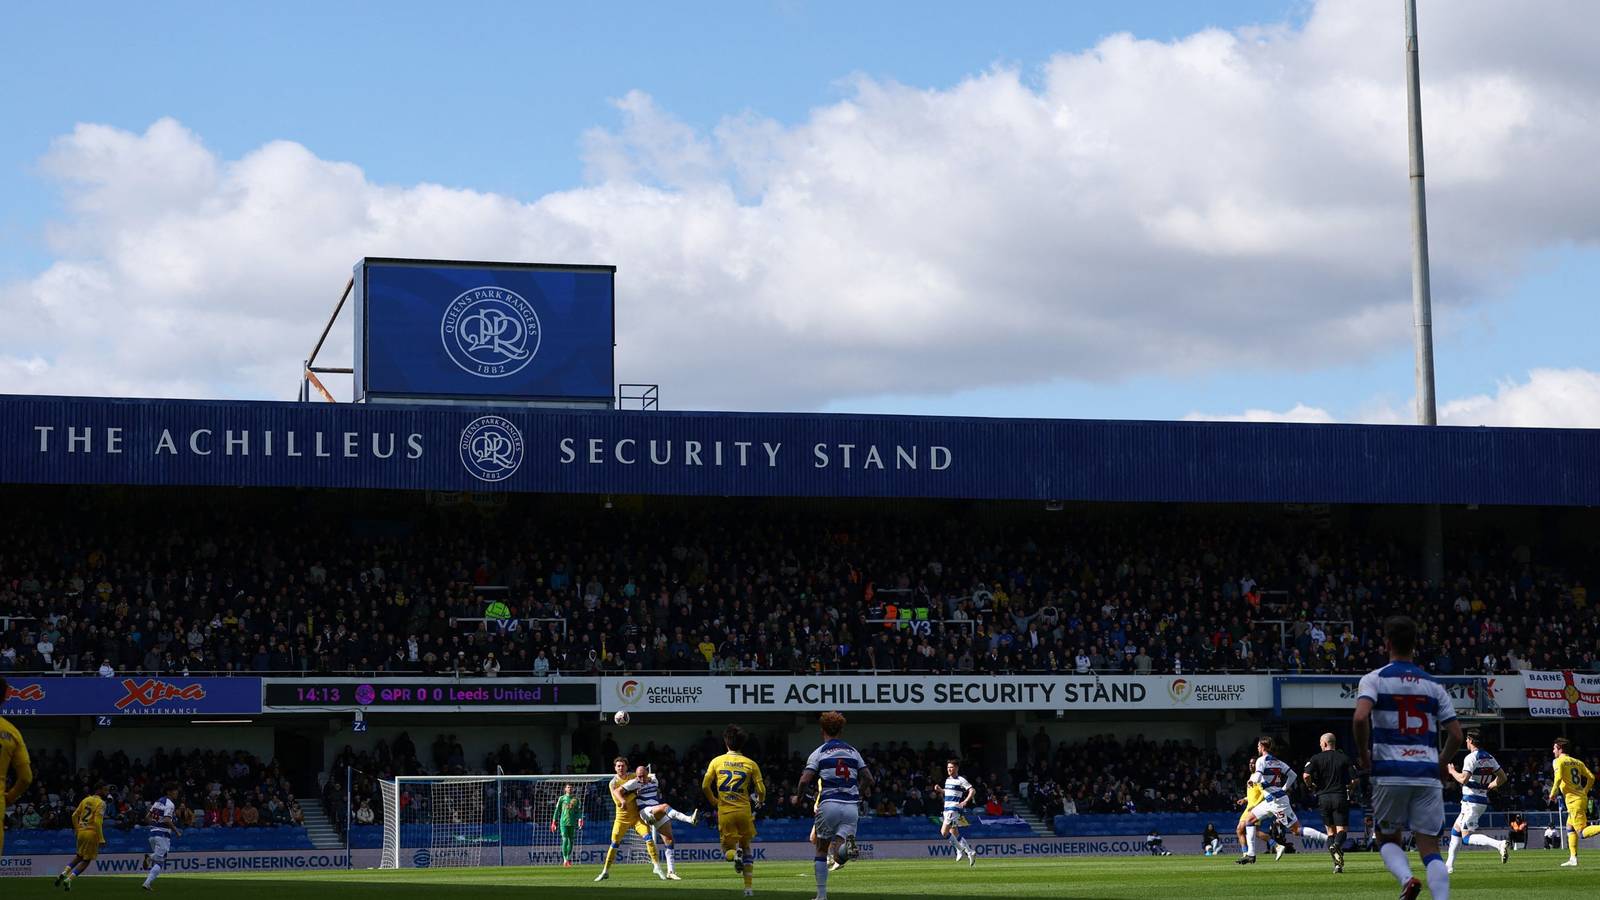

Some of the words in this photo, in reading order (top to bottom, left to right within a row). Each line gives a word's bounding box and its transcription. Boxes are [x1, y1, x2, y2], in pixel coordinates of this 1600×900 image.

[445, 295, 472, 333] QUEENS
[475, 290, 502, 300] PARK
[505, 294, 537, 336] RANGERS
[478, 364, 506, 374] 1882
[34, 425, 124, 455] THE
[155, 428, 425, 459] ACHILLEUS
[462, 422, 480, 450] QUEENS
[560, 437, 783, 468] SECURITY
[814, 443, 954, 471] STAND
[909, 621, 931, 636] Y3
[115, 678, 206, 710] Xtra
[296, 687, 341, 702] 14:13
[380, 687, 411, 702] QPR
[417, 687, 427, 702] 0
[432, 687, 443, 702] 0
[449, 687, 489, 702] Leeds
[494, 687, 541, 702] United
[646, 686, 703, 696] ACHILLEUS
[724, 683, 775, 705] THE
[783, 683, 925, 705] ACHILLEUS
[933, 682, 1056, 704] SECURITY
[1064, 681, 1147, 703] STAND
[1194, 684, 1246, 693] ACHILLEUS
[1531, 690, 1562, 698] LEEDS
[648, 695, 699, 704] SECURITY
[1196, 693, 1242, 702] SECURITY
[98, 716, 111, 726] Z5
[1392, 694, 1429, 736] 15
[353, 722, 367, 732] Z4
[835, 758, 851, 784] 4
[1571, 767, 1580, 785] 8
[719, 769, 748, 793] 22
[82, 805, 92, 823] 2
[928, 841, 1149, 857] WWOFTUS-ENGINEERING.CO.UK
